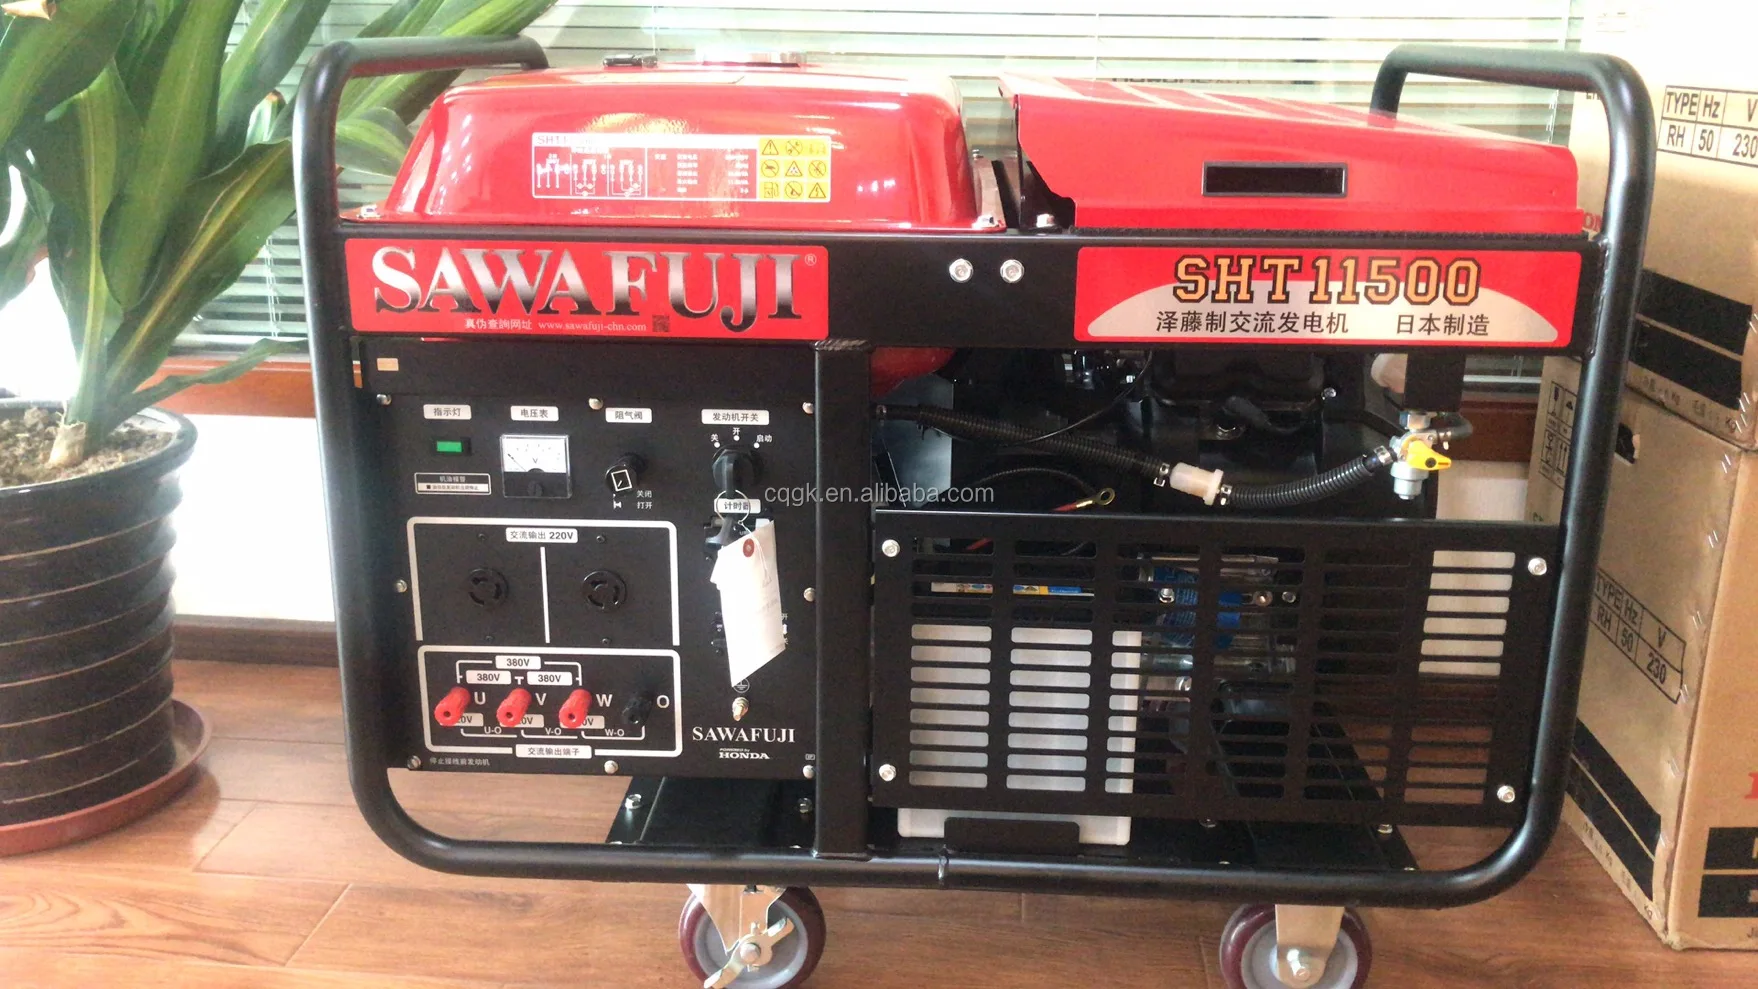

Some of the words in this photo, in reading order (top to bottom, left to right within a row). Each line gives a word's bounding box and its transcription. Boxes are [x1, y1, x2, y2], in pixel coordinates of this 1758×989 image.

[1666, 91, 1699, 116] TYPE
[1703, 95, 1720, 119] Hz
[1747, 98, 1758, 122] V
[1666, 124, 1686, 148] RH
[1698, 128, 1714, 152] 50
[1732, 133, 1758, 159] 230
[370, 246, 803, 334] SAWAFUJI
[538, 320, 647, 332] www.sawafuji-chn.com
[1155, 310, 1349, 335] 泽藤制交流发电机
[1395, 312, 1491, 337] 日本制造
[433, 407, 461, 417] 指示灯
[520, 408, 549, 419] 电压表
[614, 410, 643, 421] 阻气阀
[712, 411, 759, 422] 发动机开关
[732, 427, 741, 436] 开
[756, 434, 773, 443] 启动
[636, 501, 653, 509] 打开
[510, 530, 546, 540] 交流输出
[549, 531, 574, 540] 220V
[1624, 600, 1638, 626] Hz
[1658, 626, 1667, 648] V
[1596, 605, 1613, 632] RH
[1621, 626, 1634, 653] 50
[1646, 651, 1667, 685] 230
[506, 658, 530, 668] 380V
[476, 673, 501, 682] 380V
[537, 674, 562, 683] 380V
[474, 691, 486, 705] U
[535, 693, 547, 706] V
[596, 694, 613, 707] W
[484, 726, 502, 735] U-O
[545, 727, 562, 736] V-O
[604, 729, 625, 737] W-O
[692, 726, 796, 743] SAWAFUJI
[527, 746, 580, 757] 交流输出端子
[719, 752, 771, 760] HONDA
